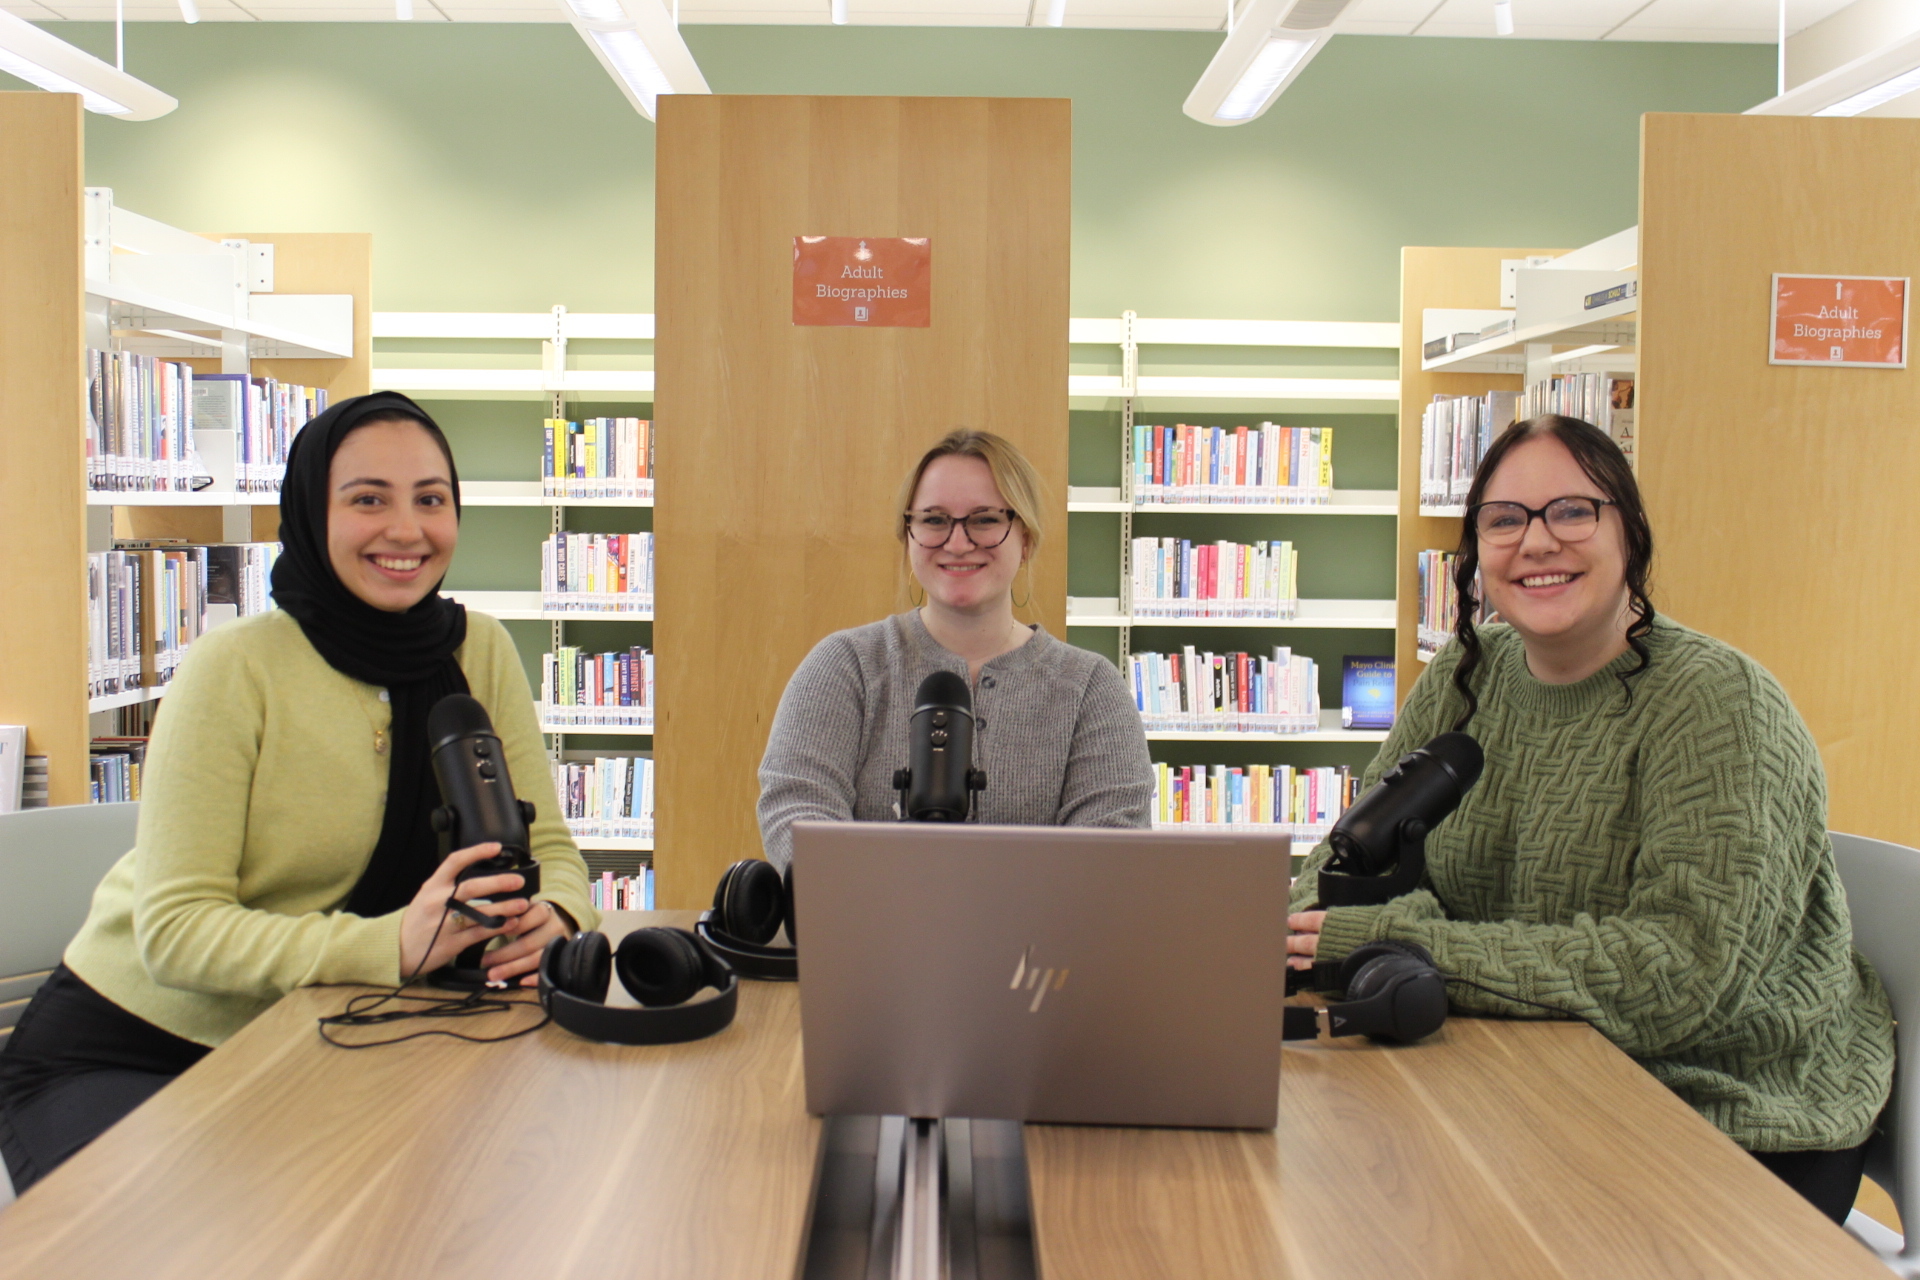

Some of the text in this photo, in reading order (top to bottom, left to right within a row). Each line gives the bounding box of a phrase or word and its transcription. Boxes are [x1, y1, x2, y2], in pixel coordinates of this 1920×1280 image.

[840, 265, 884, 279] Adult
[815, 284, 908, 301] Biographies
[1817, 305, 1859, 319] Adult
[1793, 323, 1882, 341] Biographies
[1301, 430, 1309, 457] BURN
[1351, 661, 1373, 670] Mayo
[1356, 669, 1382, 678] Guide
[630, 659, 639, 692] LADYPARTS
[1009, 943, 1069, 1012] hp
